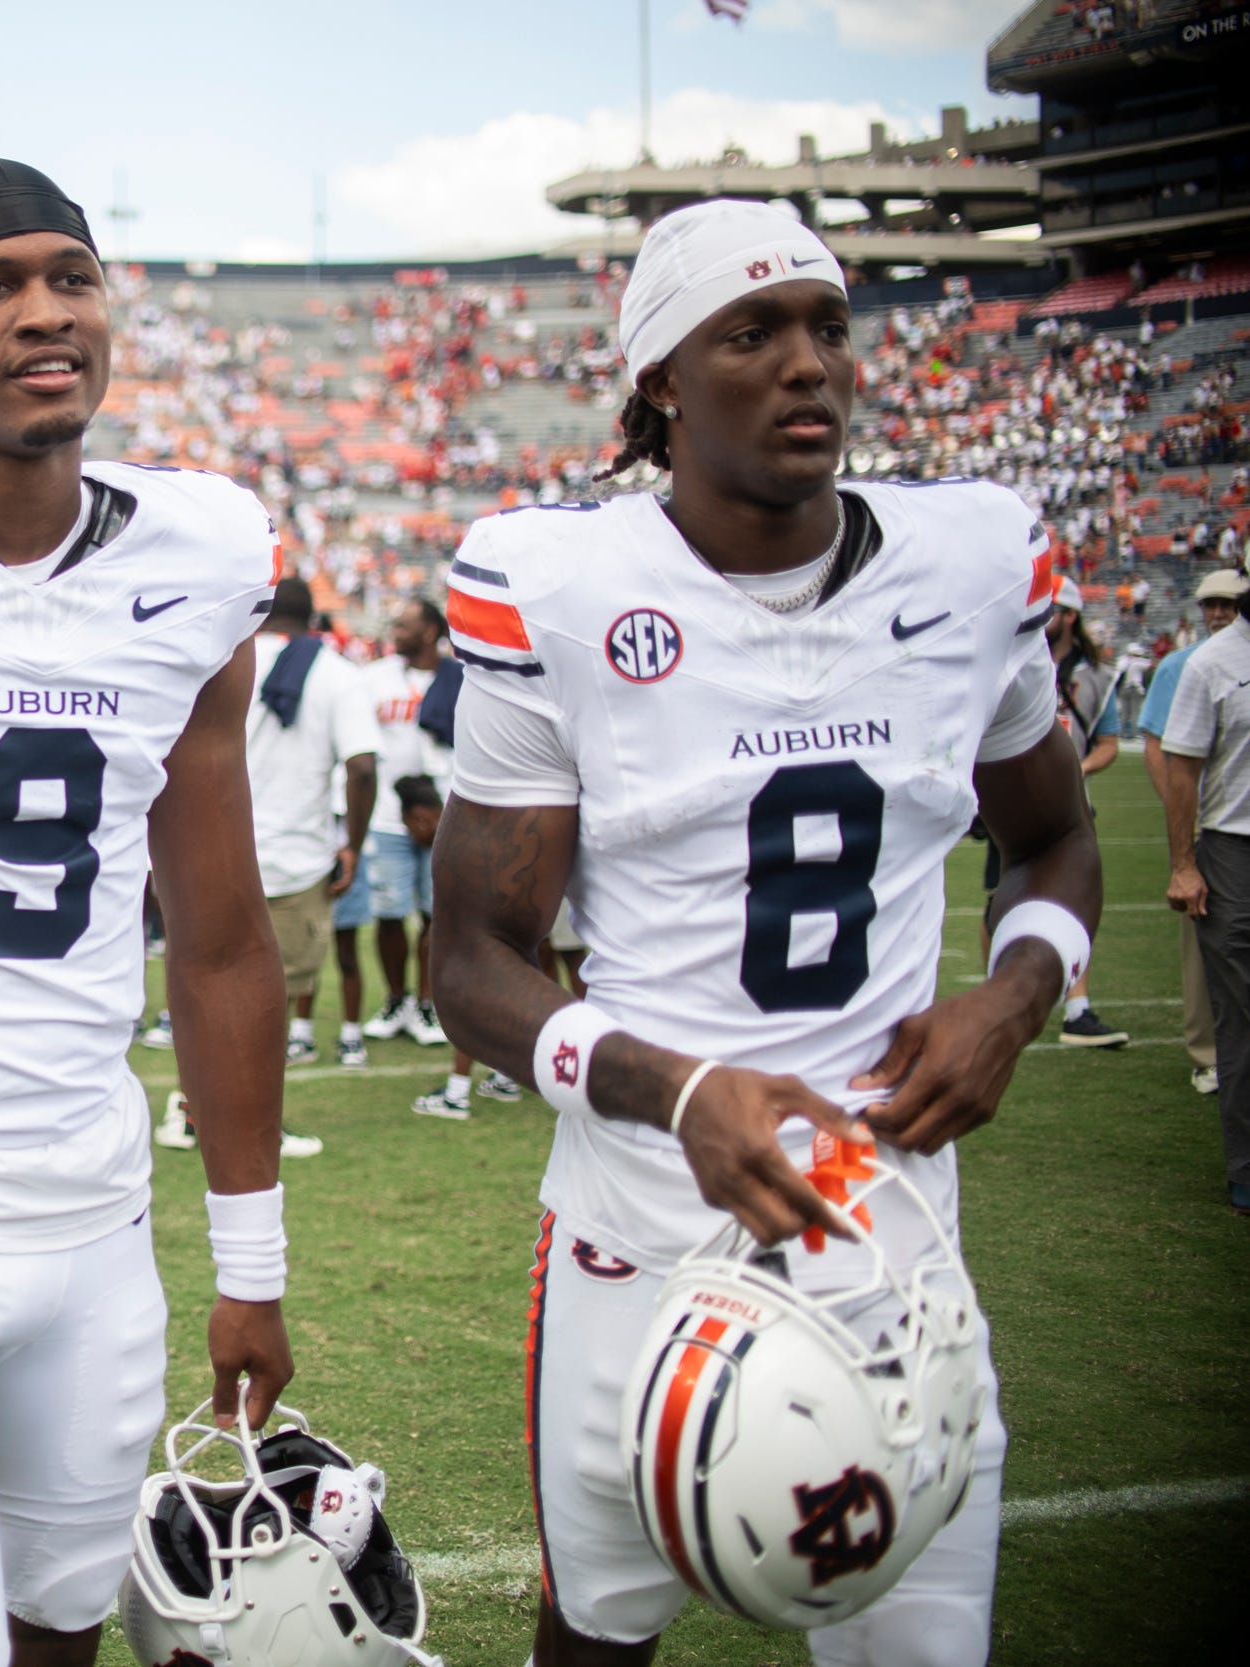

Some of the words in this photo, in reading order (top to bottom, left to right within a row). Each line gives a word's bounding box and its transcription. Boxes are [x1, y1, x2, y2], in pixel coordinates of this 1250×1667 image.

[1183, 24, 1208, 42] ON
[1212, 15, 1238, 35] THE
[608, 611, 680, 681] SEC
[730, 719, 892, 759] AUBURN
[739, 759, 885, 1013] 8
[692, 1292, 762, 1325] TIGERS
